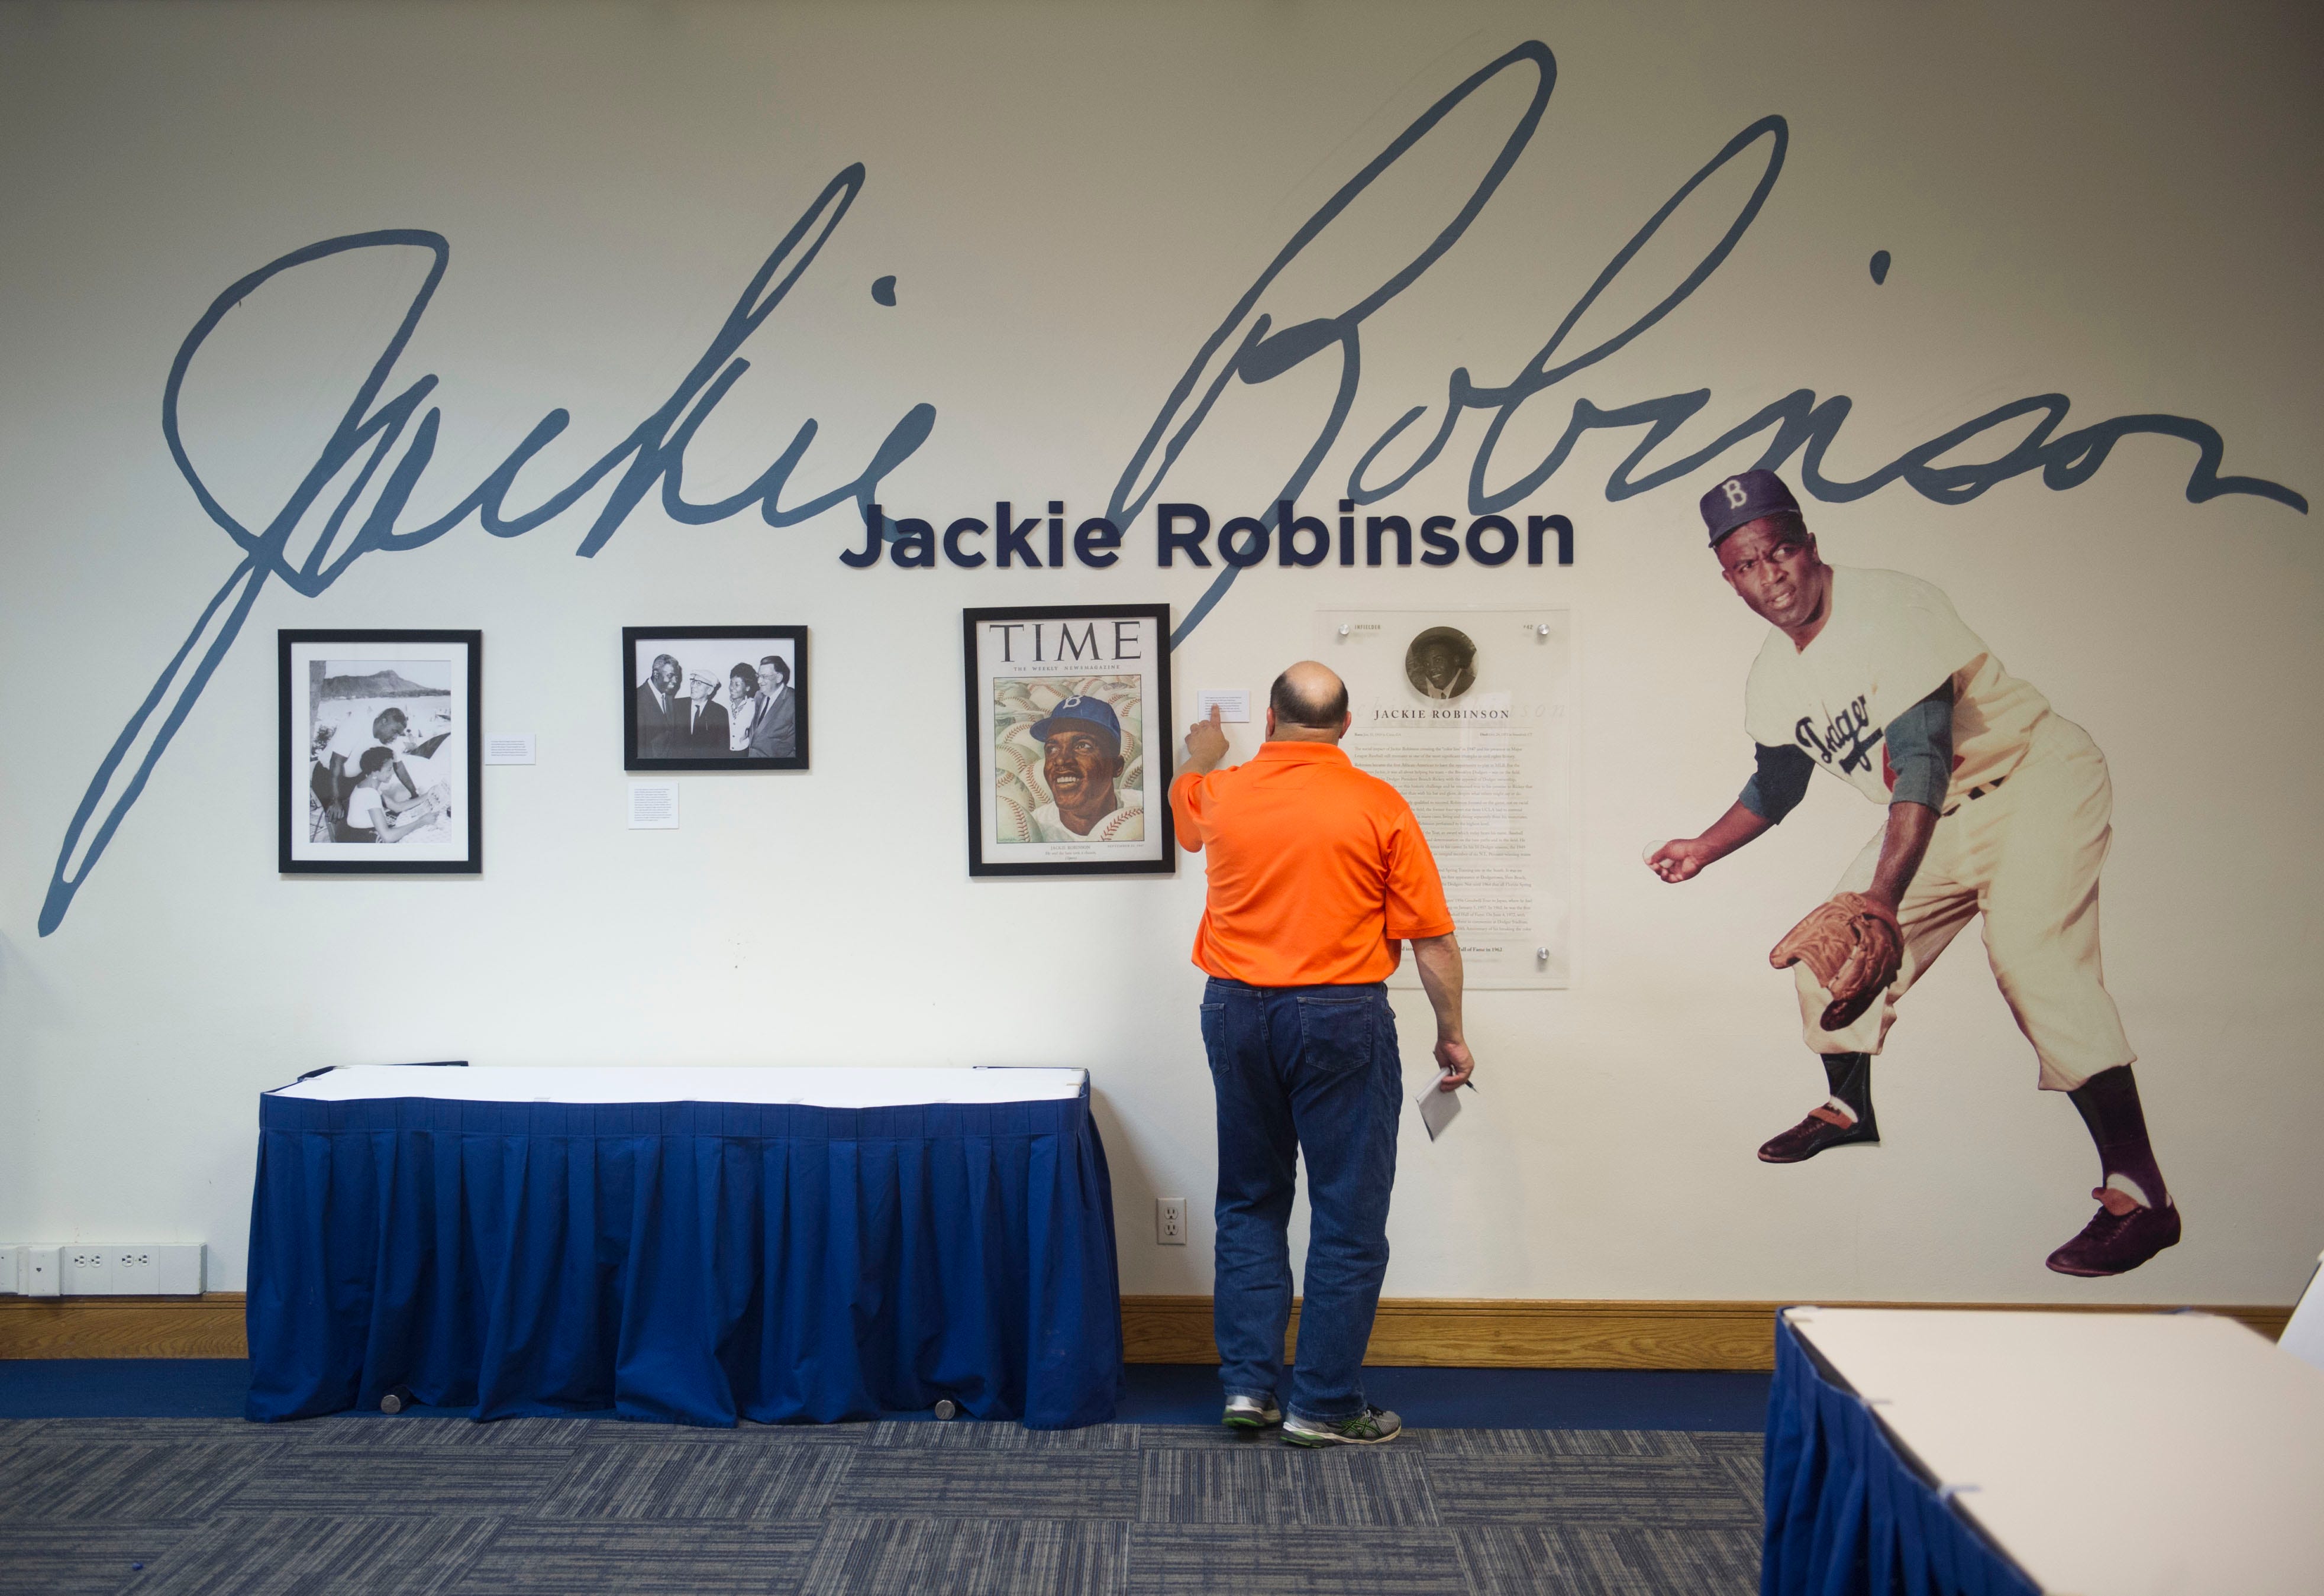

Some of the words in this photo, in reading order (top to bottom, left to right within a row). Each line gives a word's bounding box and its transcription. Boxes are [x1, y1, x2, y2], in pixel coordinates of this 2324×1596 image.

[1722, 479, 1748, 510] B
[839, 500, 1122, 568] Jackie
[1156, 499, 1574, 568] Robinson
[990, 621, 1141, 662] TIME
[1374, 709, 1426, 721] JACKIE
[1432, 709, 1510, 720] ROBINSON
